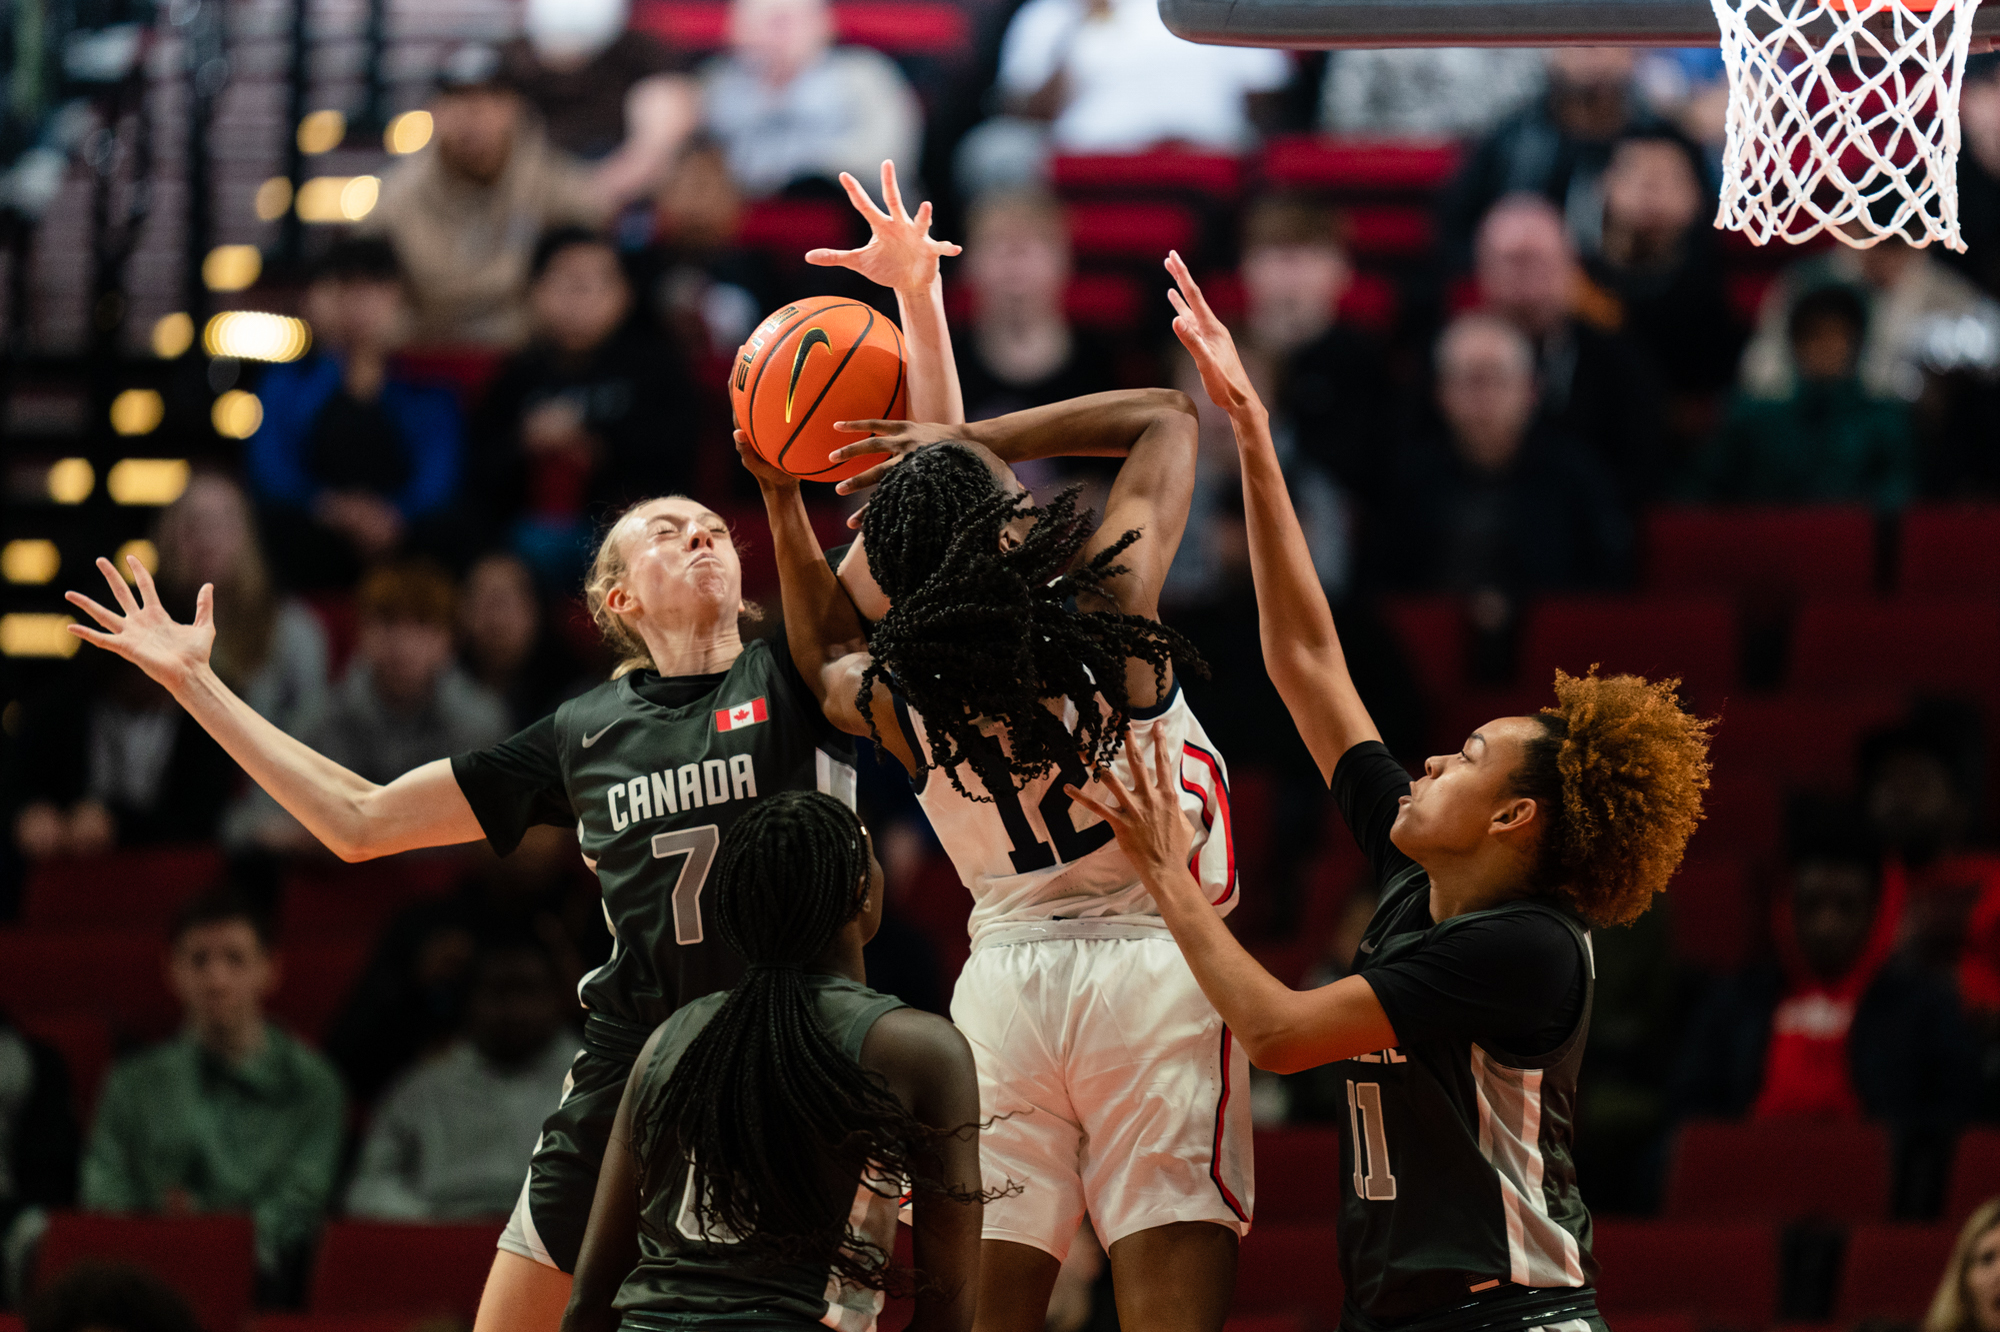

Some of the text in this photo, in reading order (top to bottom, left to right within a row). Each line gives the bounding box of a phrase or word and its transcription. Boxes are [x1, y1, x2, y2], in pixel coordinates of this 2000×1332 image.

[735, 305, 801, 393] ELITE
[607, 753, 758, 832] CANADA
[970, 718, 1116, 874] 12
[651, 823, 720, 946] 7
